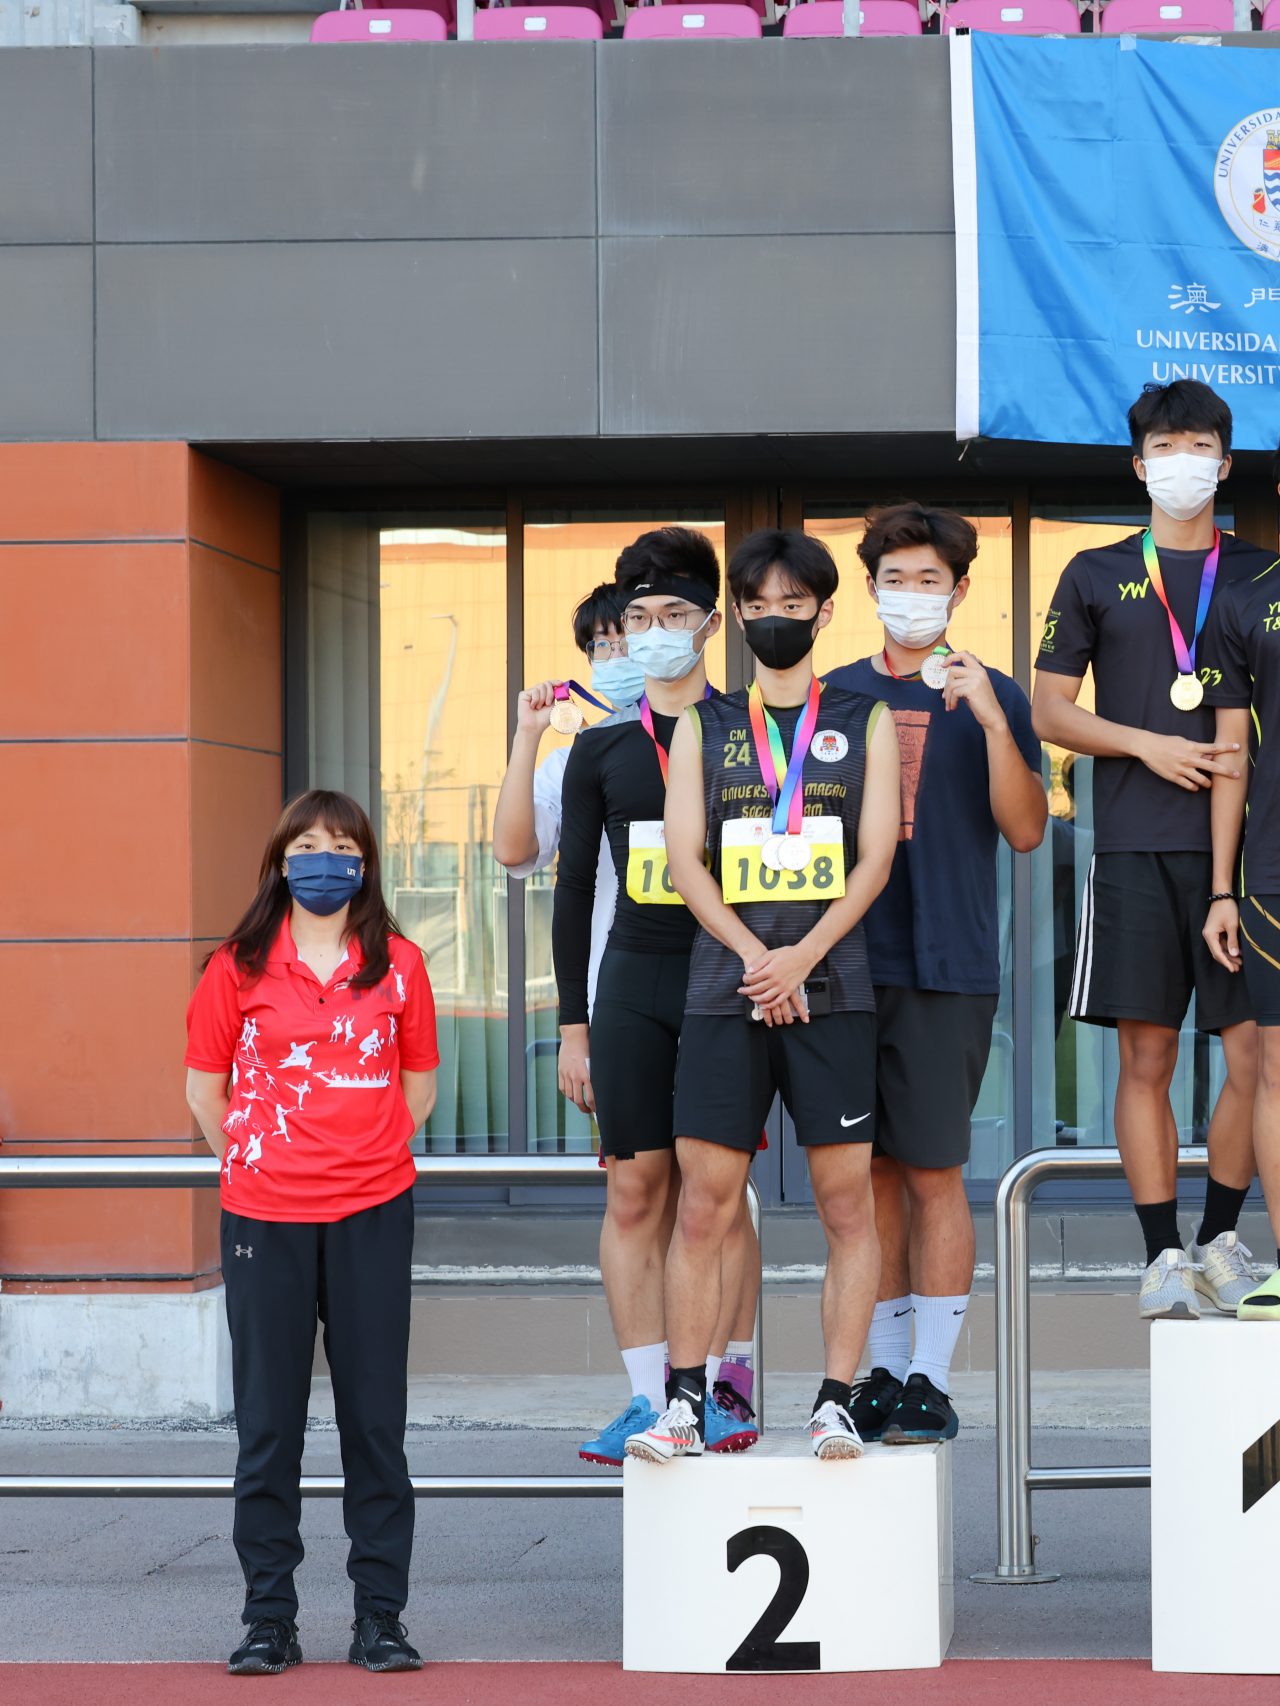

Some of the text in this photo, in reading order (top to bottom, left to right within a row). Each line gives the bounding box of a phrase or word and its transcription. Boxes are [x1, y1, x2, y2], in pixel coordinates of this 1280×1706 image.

[1118, 577, 1150, 601] YW
[1200, 667, 1223, 687] 23
[729, 729, 747, 741] CM
[723, 742, 752, 768] 24
[726, 1525, 820, 1671] 2
